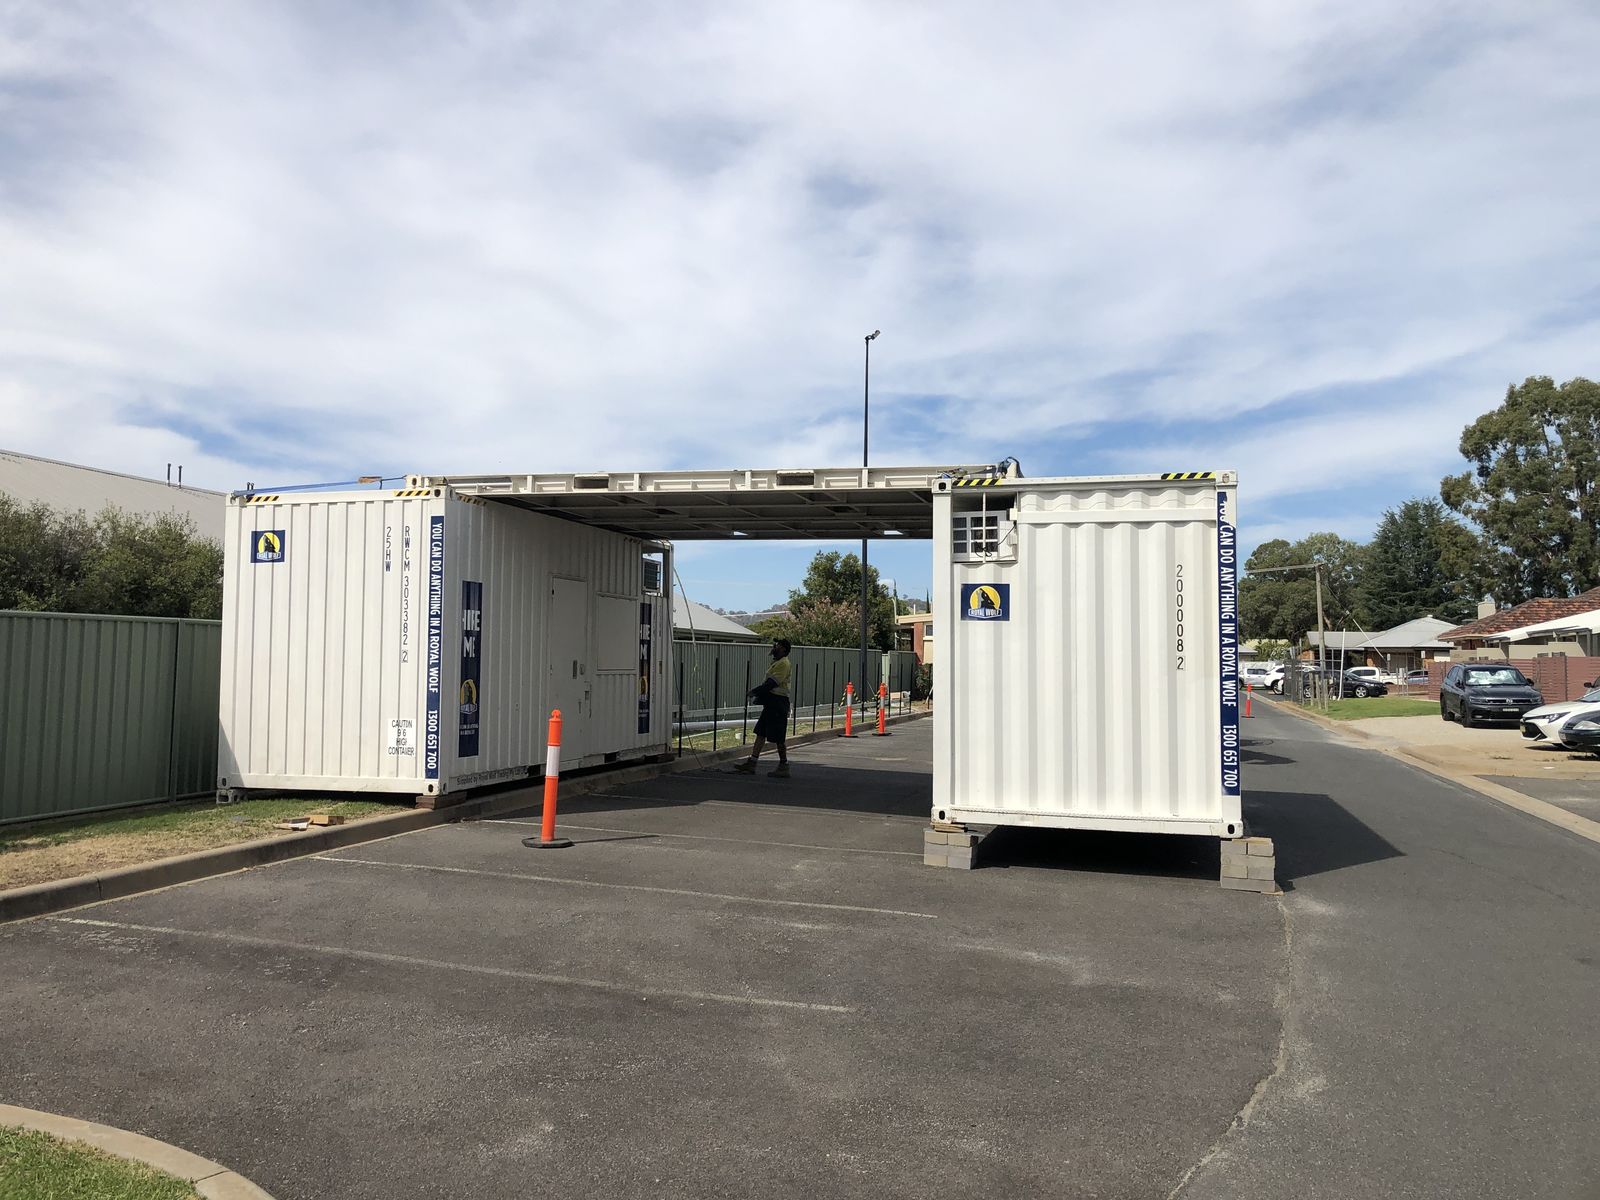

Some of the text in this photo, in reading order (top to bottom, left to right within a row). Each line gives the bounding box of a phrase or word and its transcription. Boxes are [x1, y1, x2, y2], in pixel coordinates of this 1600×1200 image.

[432, 522, 442, 540] YOU
[1220, 525, 1234, 546] CAN
[432, 541, 442, 558] CAN
[1220, 549, 1234, 563] DO
[431, 560, 442, 571] DO
[430, 574, 441, 615] ANYTHING
[1220, 567, 1235, 619] ANYTHING
[430, 617, 440, 626] IN
[1222, 623, 1235, 634] IN
[429, 636, 440, 665] ROYAL
[1222, 647, 1236, 677] ROYAL
[428, 667, 439, 693] WOLF
[1222, 680, 1236, 706] WOLF
[428, 710, 438, 732] 1300
[427, 734, 437, 749] 651
[1223, 724, 1237, 747] 1300
[427, 751, 437, 769] 700
[1223, 750, 1237, 766] 651
[1224, 769, 1237, 787] 700
